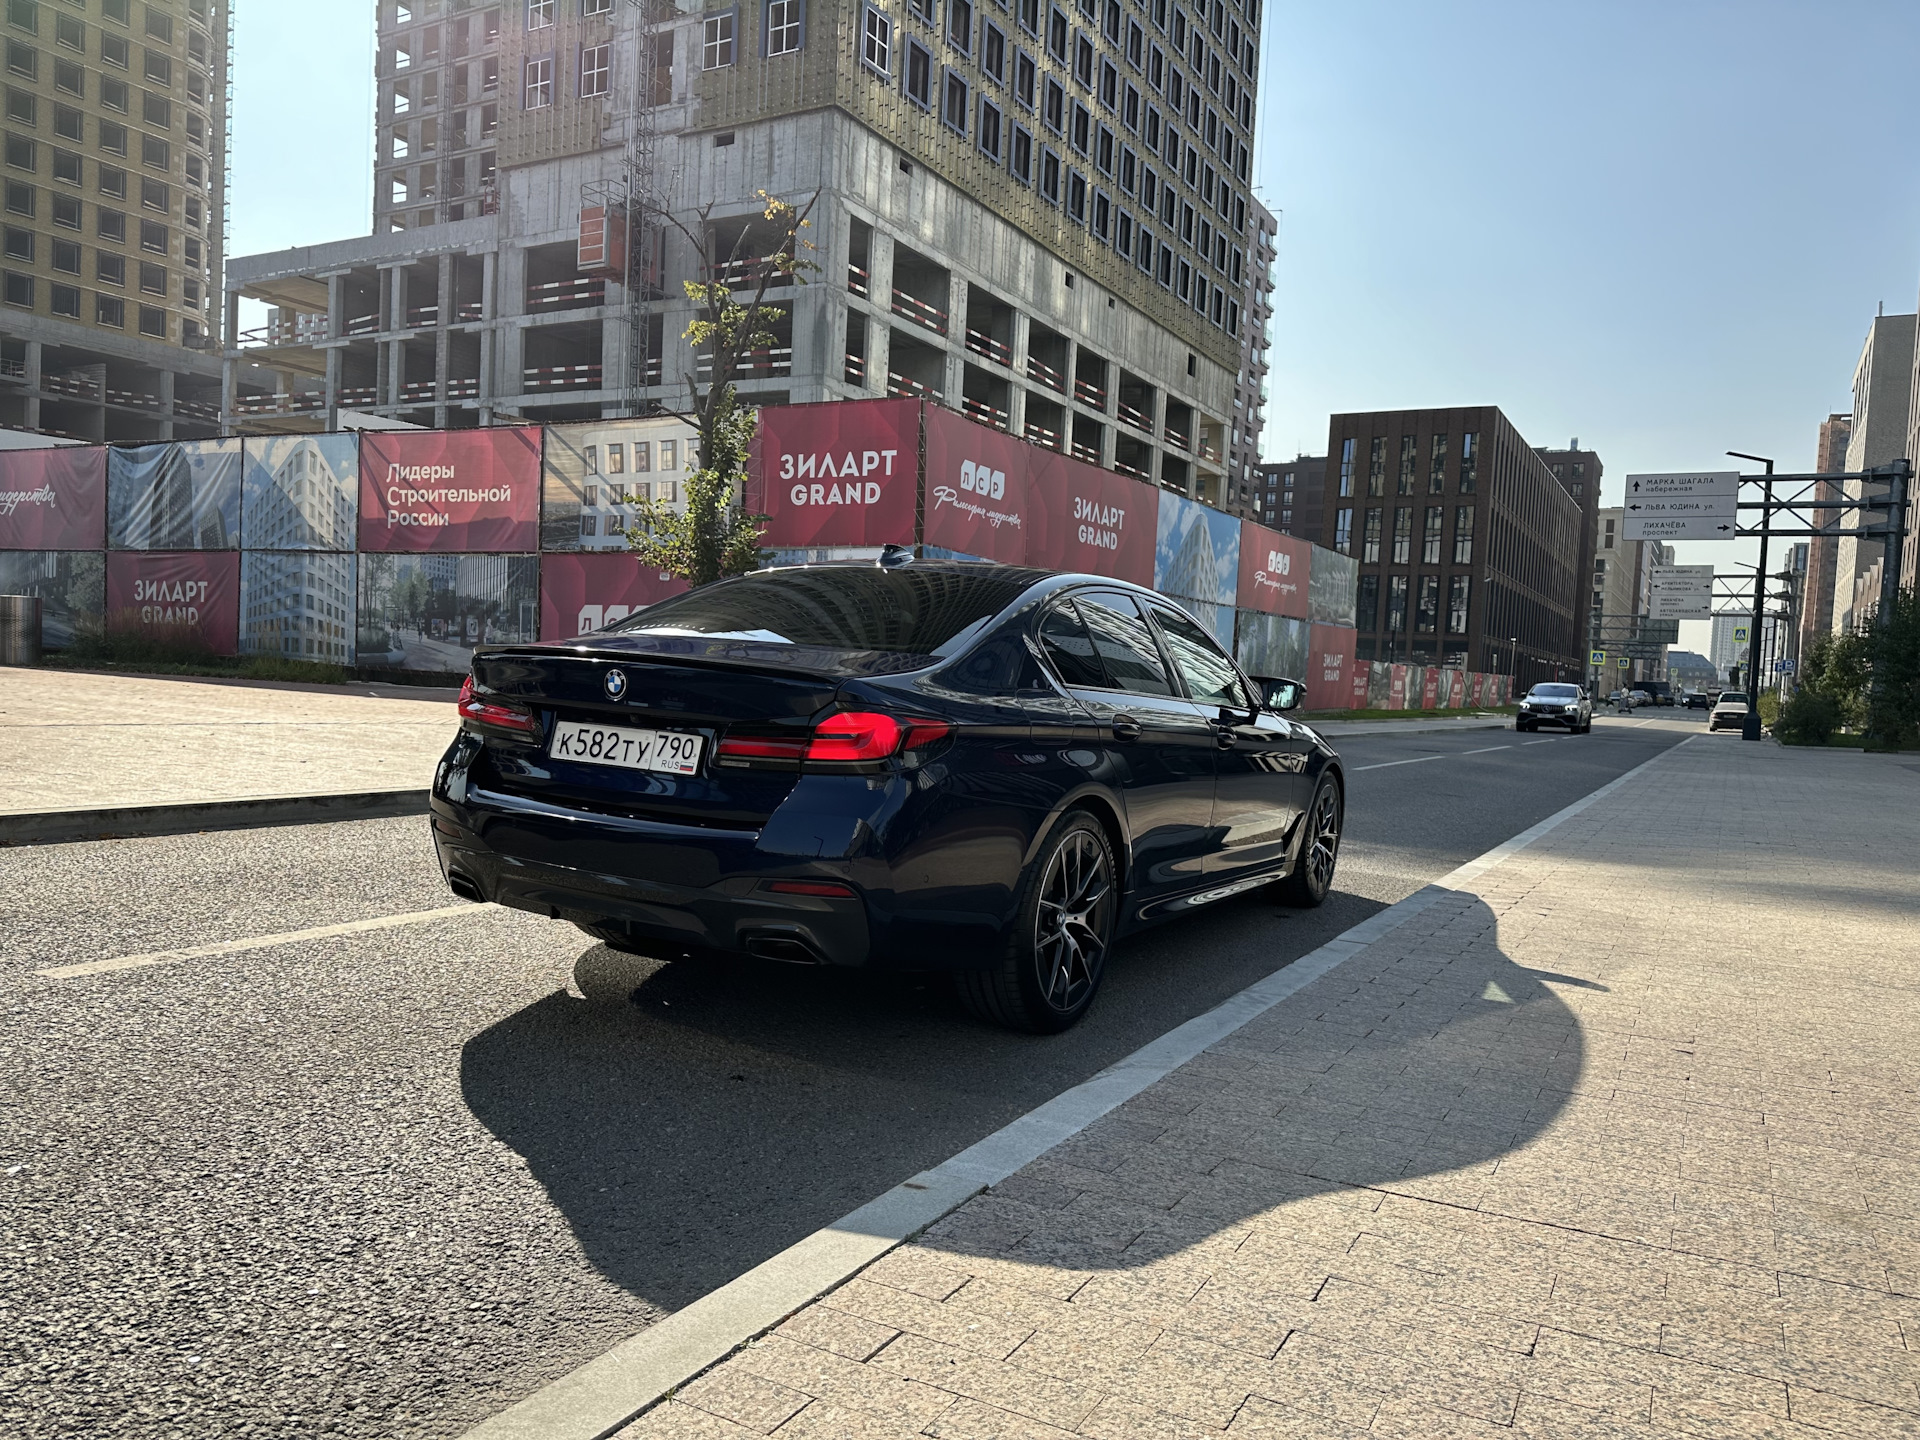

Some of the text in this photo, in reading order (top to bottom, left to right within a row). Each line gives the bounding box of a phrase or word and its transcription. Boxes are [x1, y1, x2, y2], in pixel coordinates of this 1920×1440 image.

[386, 463, 455, 483] Лидеры
[780, 449, 898, 479] ЗИЛАРТ
[962, 468, 1002, 496] ЛСР
[1679, 477, 1715, 485] ШАГАЛА
[0, 483, 56, 517] идерства
[386, 484, 511, 507] Строительной
[790, 482, 881, 506] GRAND
[1073, 496, 1125, 530] ЗИЛАРТ
[1669, 503, 1700, 511] ЮДИНА
[387, 509, 449, 529] России
[1643, 521, 1686, 529] ЛИХАЧЁВА
[1077, 524, 1118, 550] GRAND
[134, 580, 208, 603] ЗИЛАРТ
[141, 605, 199, 626] GRAND
[1323, 653, 1343, 667] ЗИЛАРТ
[558, 728, 695, 763] К582ТУ 790
[661, 760, 680, 770] RUS
